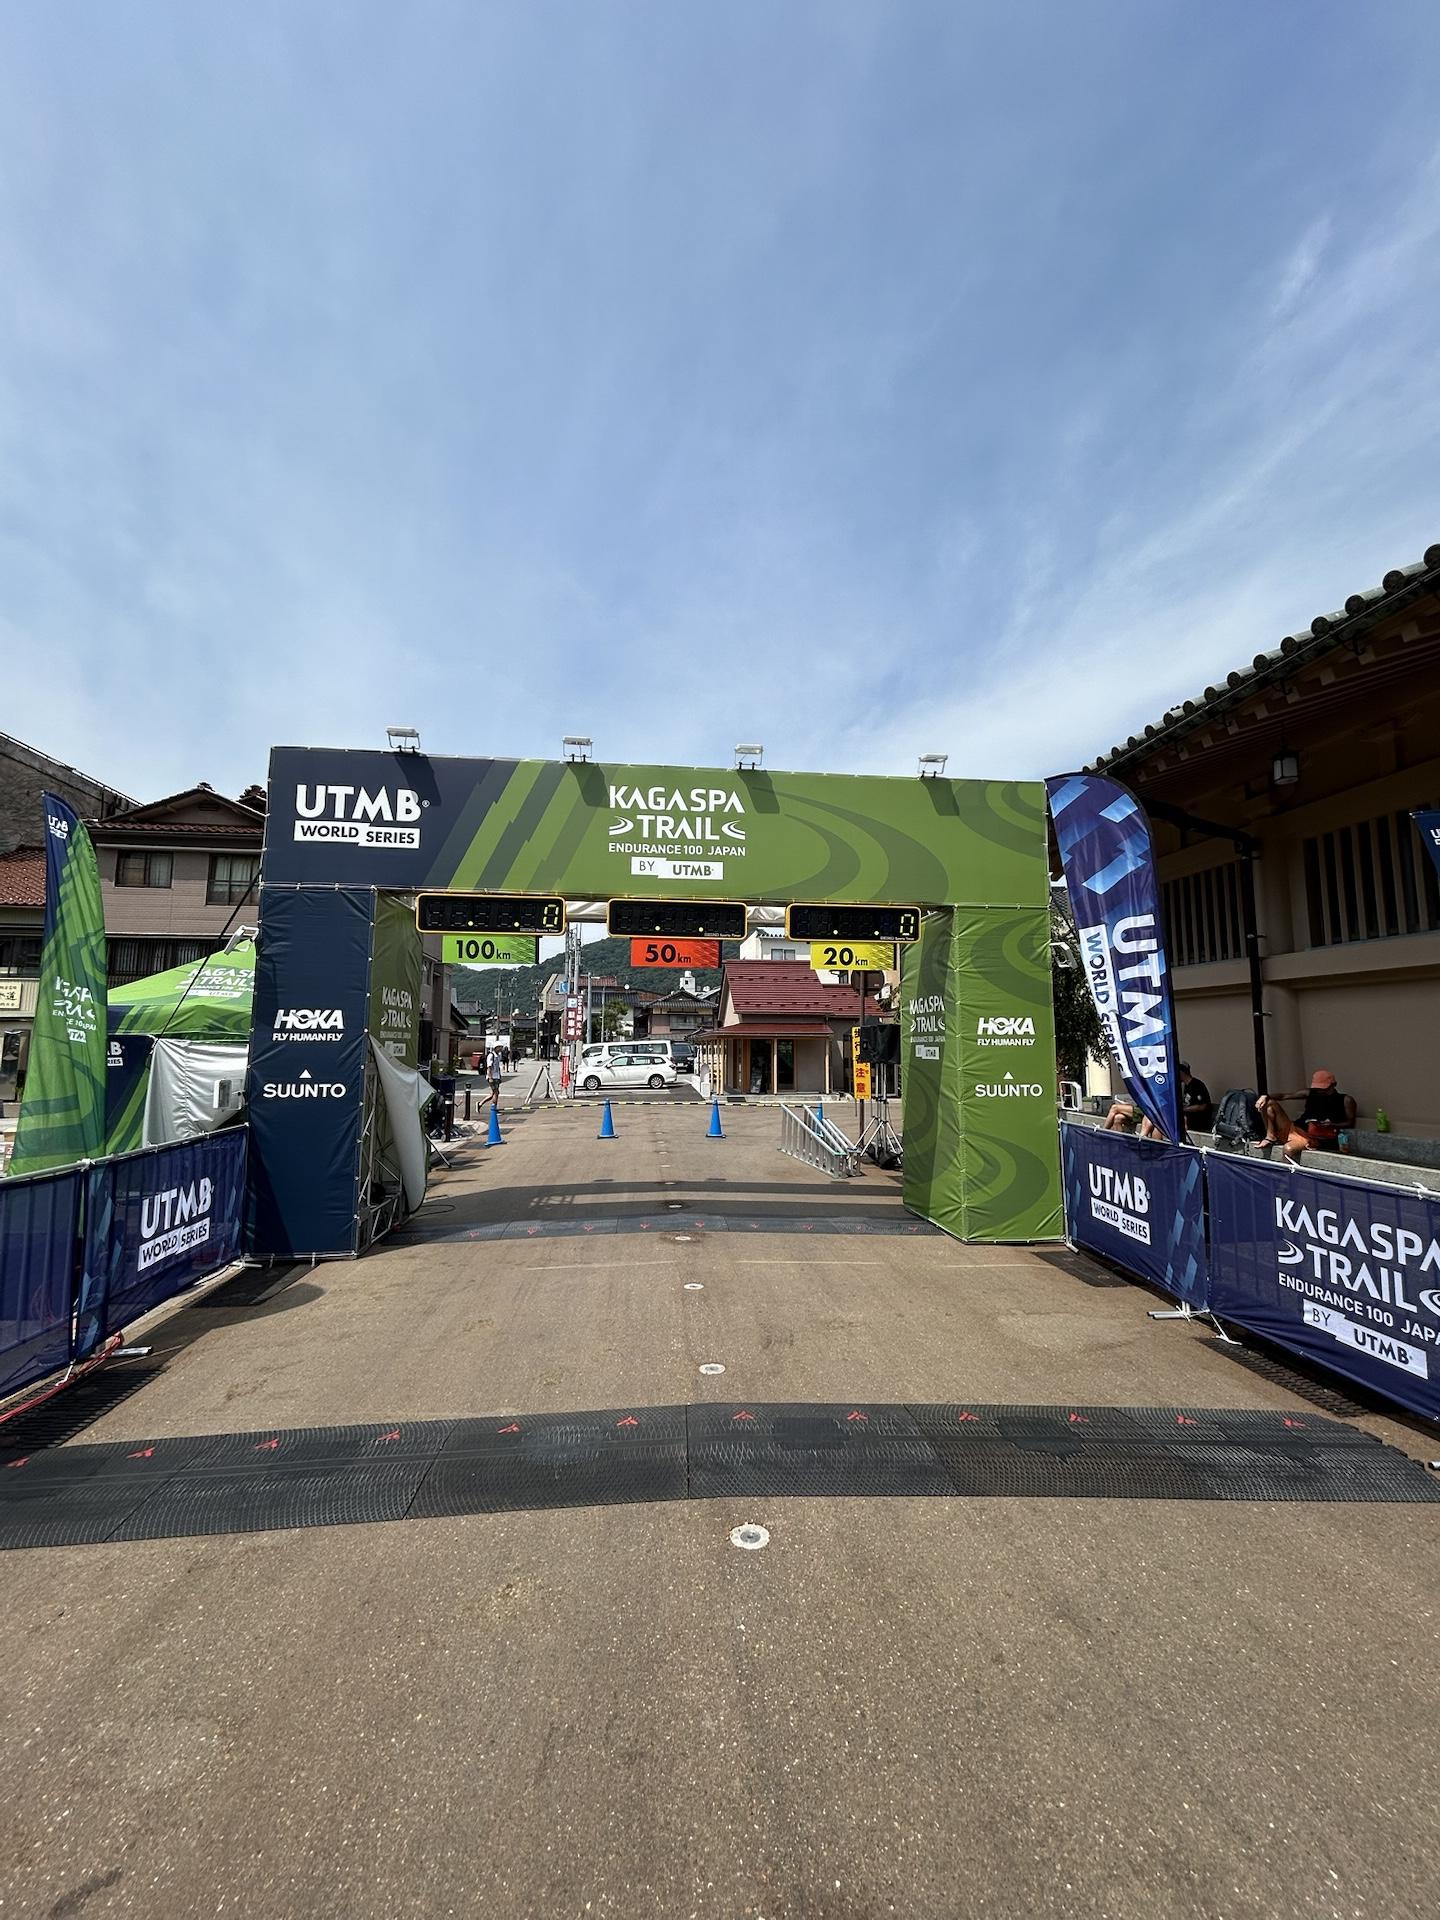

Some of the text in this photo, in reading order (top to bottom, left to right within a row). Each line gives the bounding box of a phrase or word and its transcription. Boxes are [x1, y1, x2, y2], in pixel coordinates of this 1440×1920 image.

[300, 825, 415, 844] WORLD SERIES
[636, 815, 720, 841] TRAIL
[608, 842, 746, 857] ENDURANCE 100 JAPAN
[639, 860, 655, 871] BY
[1086, 932, 1110, 1004] WORLD
[274, 1009, 344, 1029] HOKA
[916, 1015, 938, 1032] TRAIL
[977, 1017, 1035, 1035] HOKA
[272, 1033, 344, 1041] FLY HUMAN FLY
[977, 1038, 1036, 1046] FLY HUMAN FLY
[263, 1083, 346, 1098] SUUNTO
[975, 1084, 1043, 1097] SUUNTO
[1093, 1202, 1148, 1239] WORLD SERIES
[142, 1223, 207, 1263] WORLD SERIES
[1306, 1243, 1418, 1313] TRAIL
[1278, 1272, 1364, 1316] ENDURANCE
[1365, 1305, 1394, 1327] 100
[1312, 1309, 1331, 1326] BY
